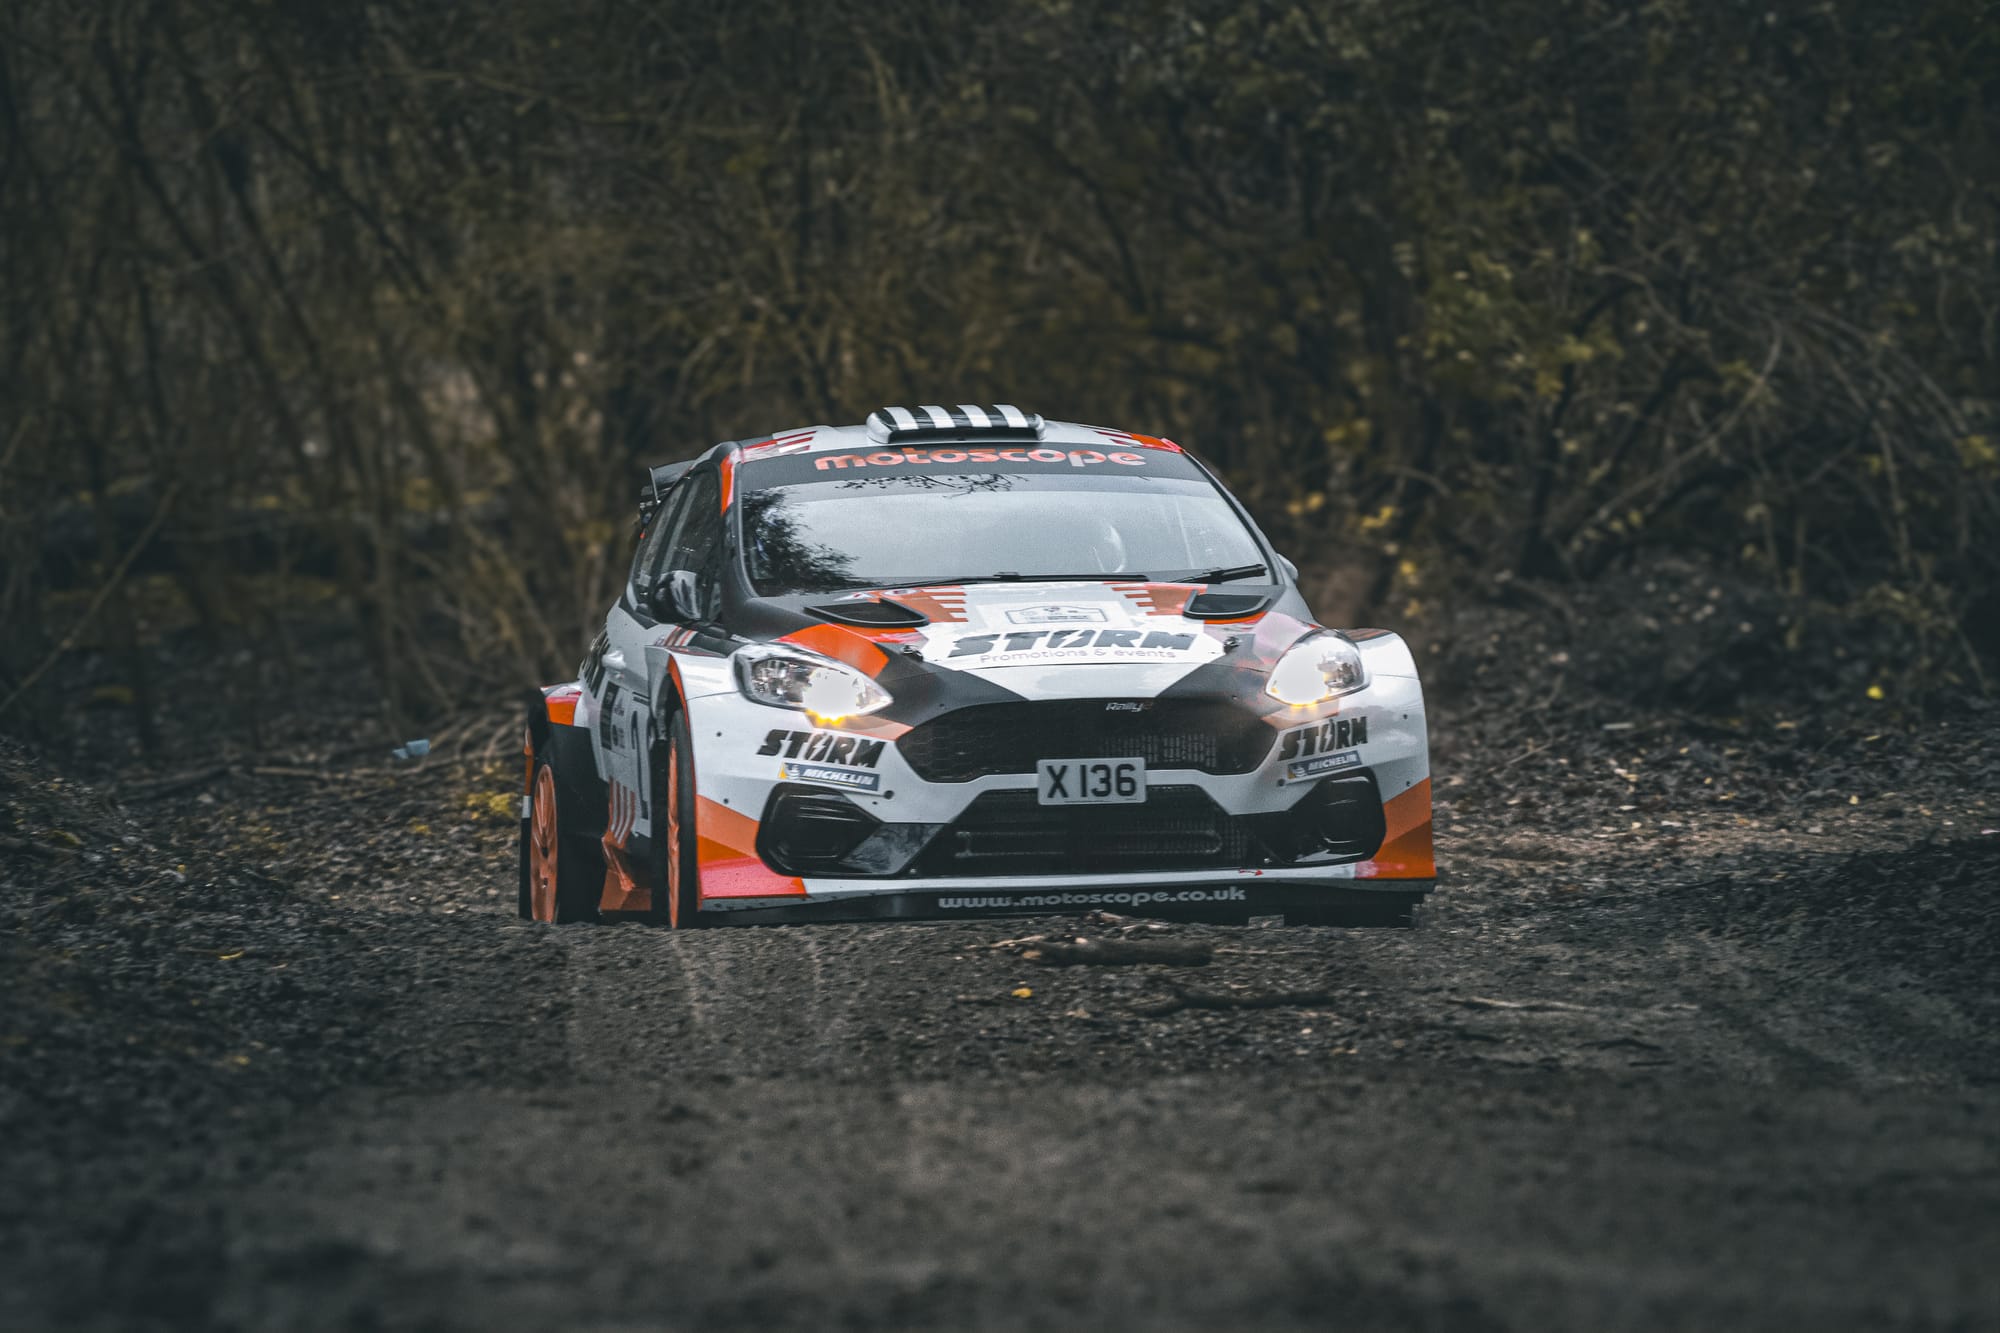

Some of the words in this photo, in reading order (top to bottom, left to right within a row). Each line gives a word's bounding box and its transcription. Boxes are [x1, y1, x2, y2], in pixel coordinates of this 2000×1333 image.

[813, 447, 1147, 471] motoscope
[980, 649, 1087, 664] Promotions
[1095, 648, 1107, 656] &
[1114, 649, 1177, 659] events
[1308, 753, 1357, 771] MICHELIN
[803, 767, 874, 785] MICHELIN
[938, 886, 1246, 908] www.motoscope.co.uk
